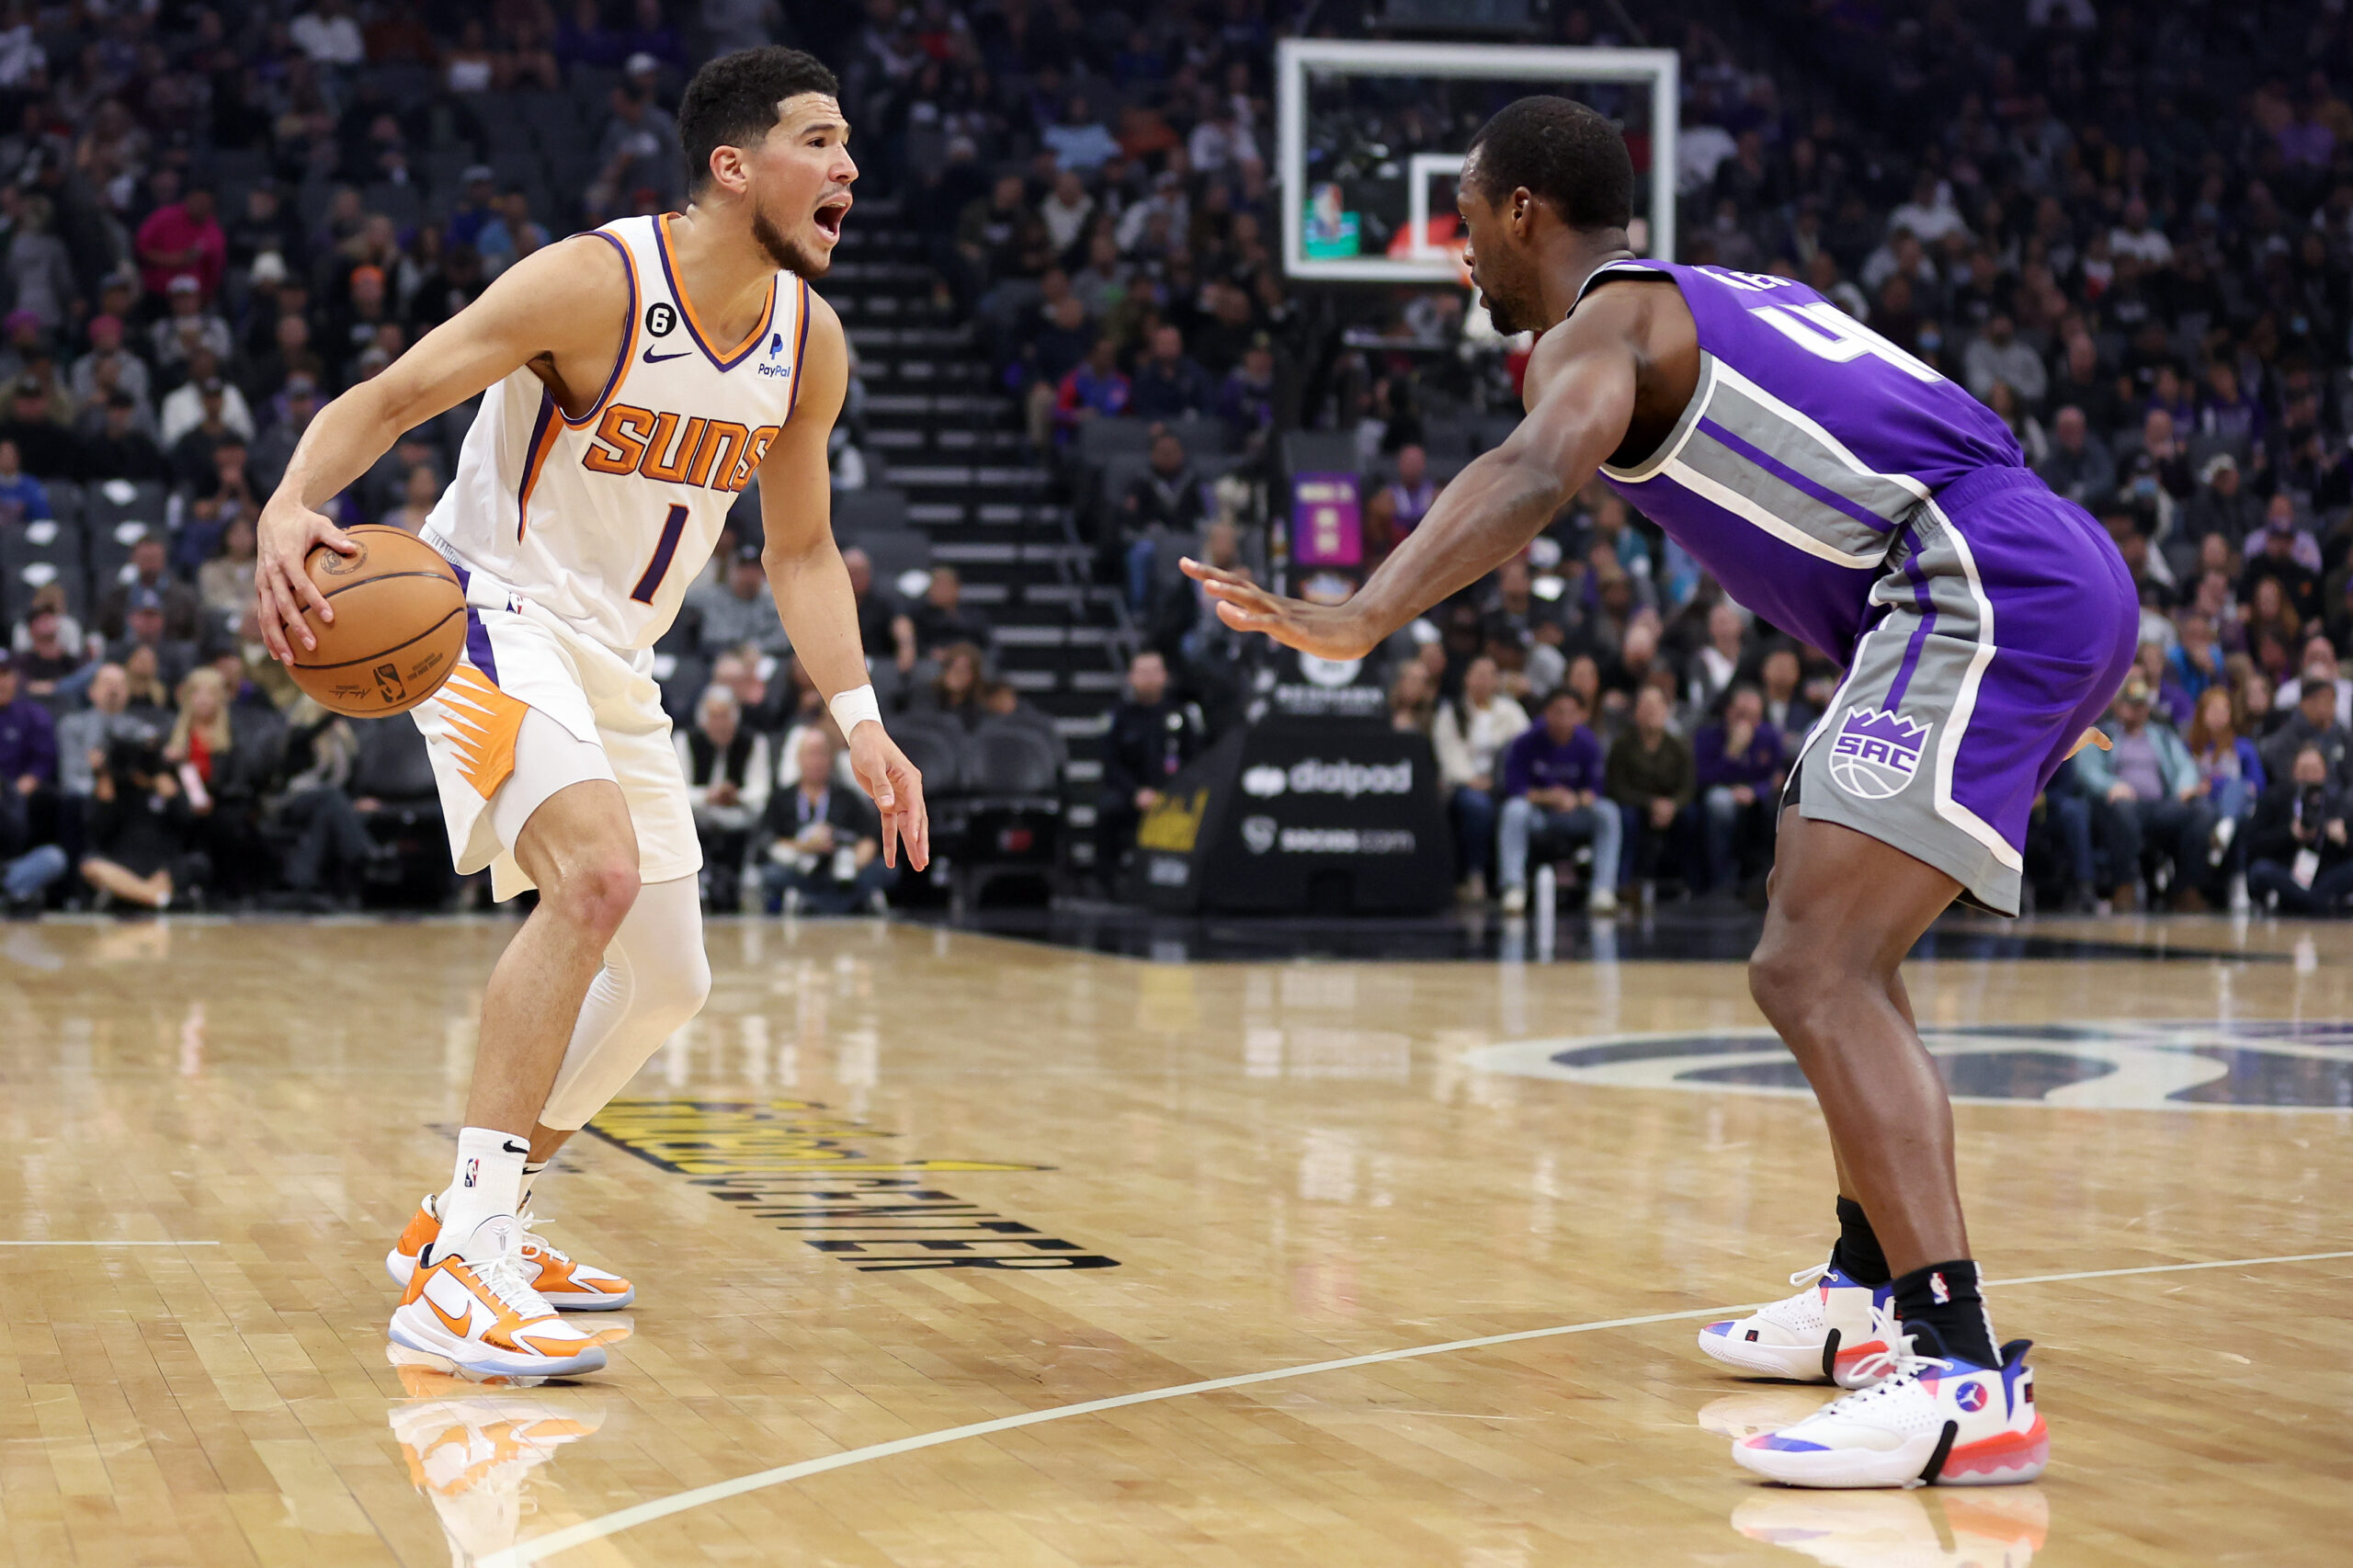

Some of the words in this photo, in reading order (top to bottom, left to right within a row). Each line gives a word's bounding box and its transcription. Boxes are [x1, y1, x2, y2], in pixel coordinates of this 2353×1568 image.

[651, 306, 670, 334] 6
[758, 363, 790, 378] PayPal
[582, 403, 780, 494] SUNS
[630, 503, 689, 606] 1
[1834, 735, 1917, 774] SAC
[1288, 758, 1414, 799] dialpad
[687, 1176, 1122, 1272] CENTER
